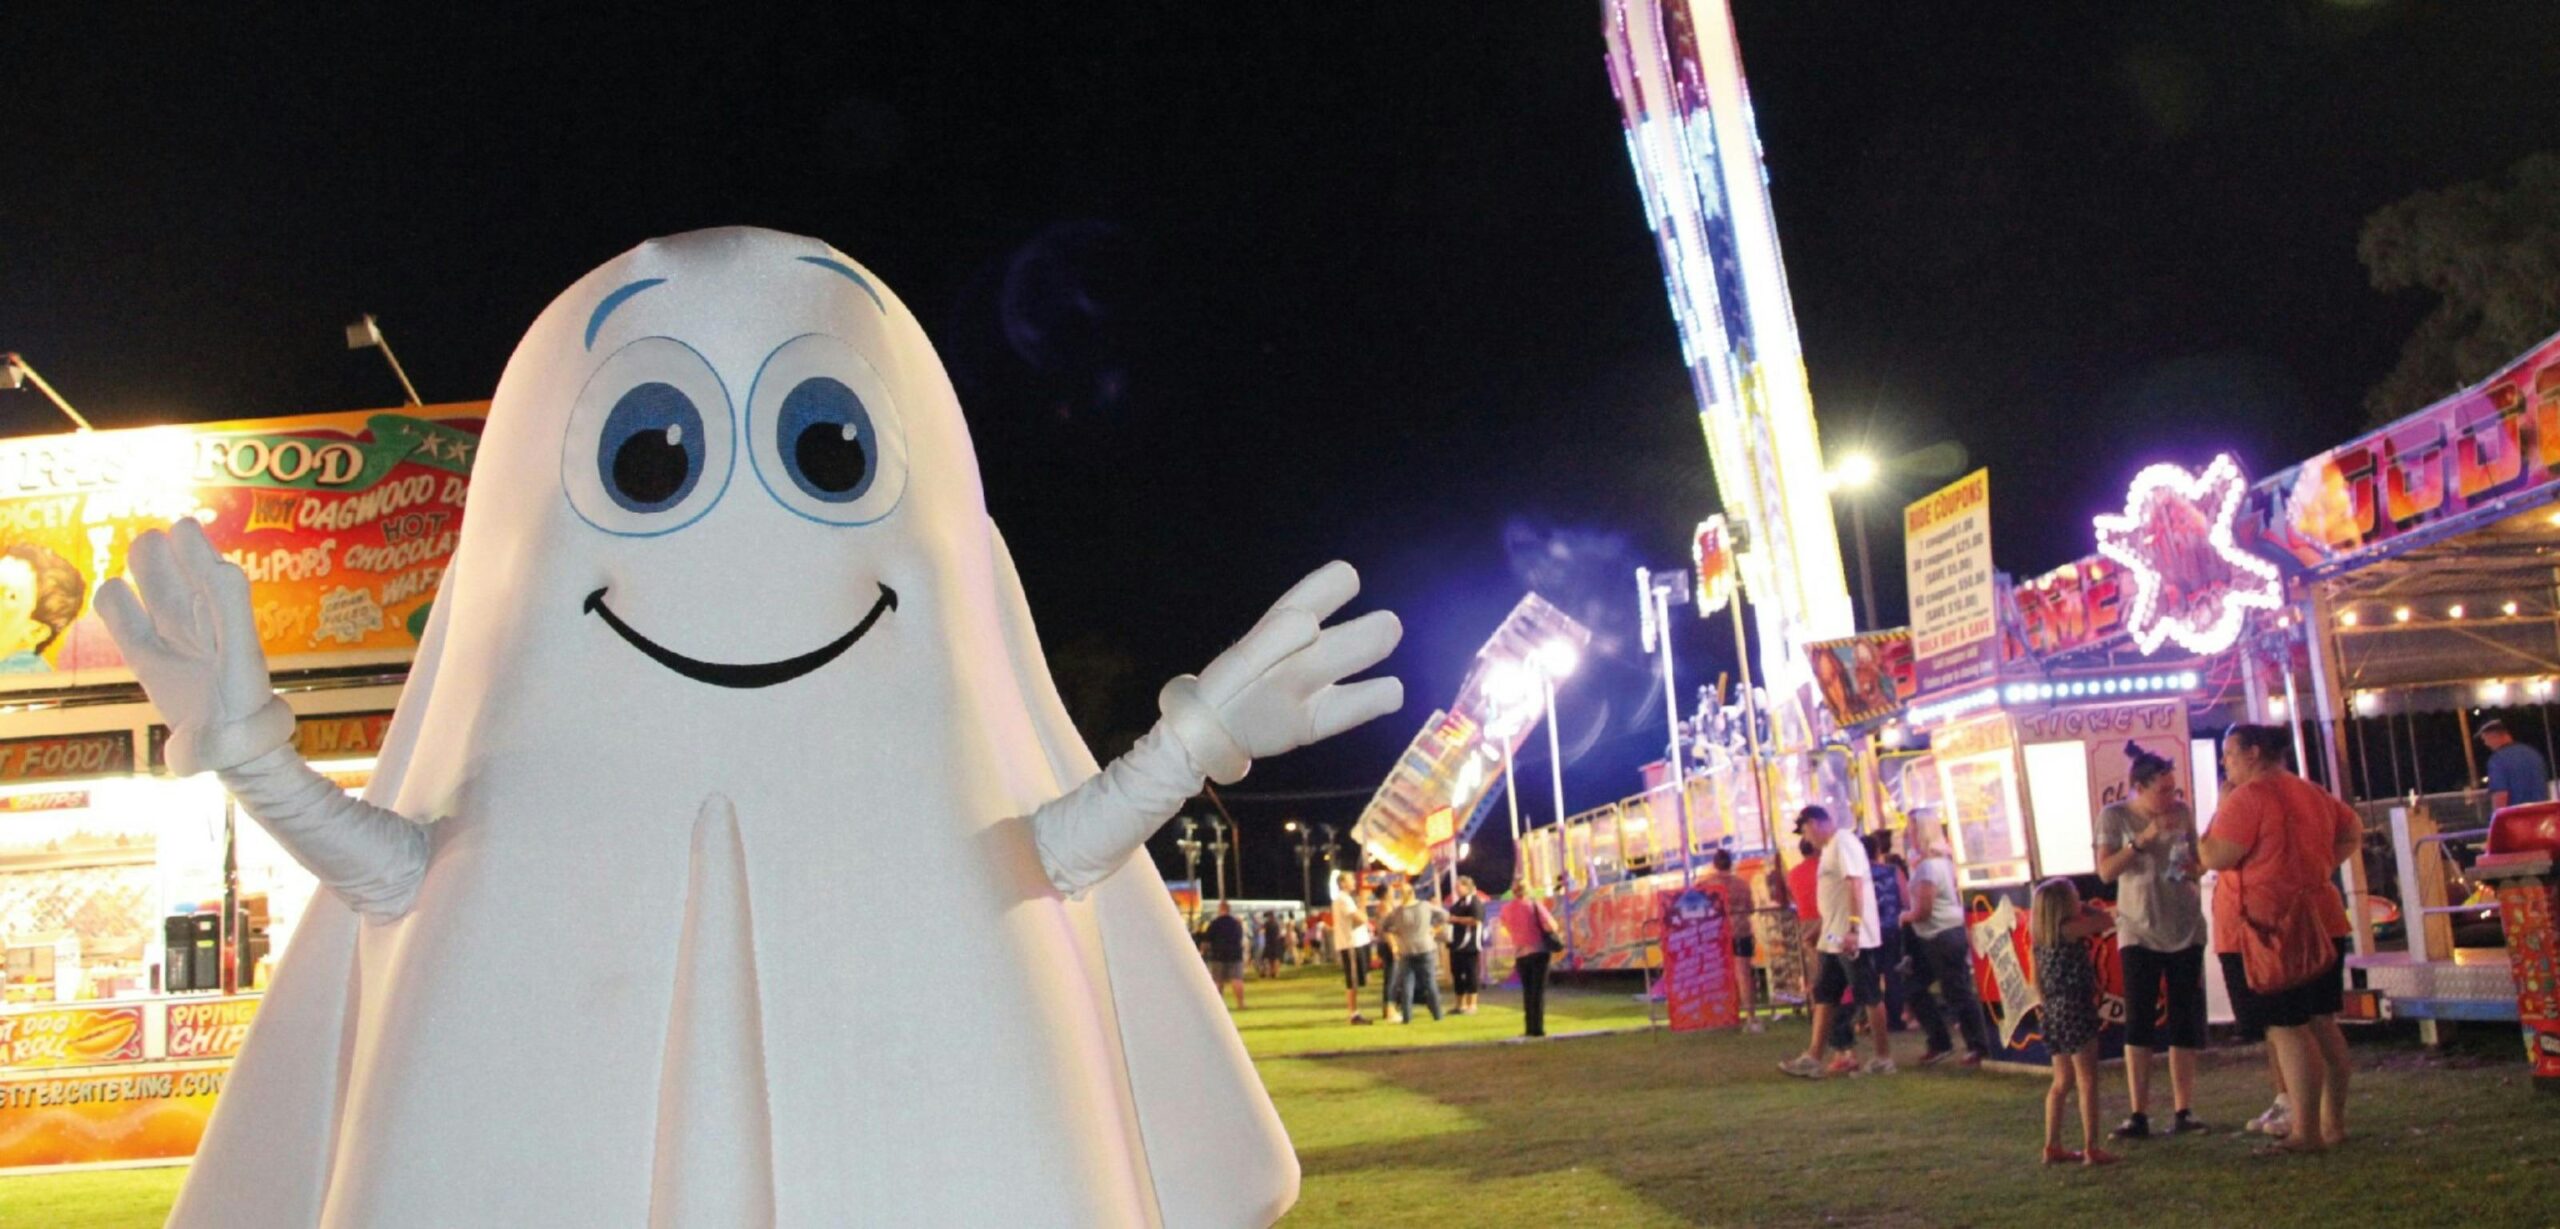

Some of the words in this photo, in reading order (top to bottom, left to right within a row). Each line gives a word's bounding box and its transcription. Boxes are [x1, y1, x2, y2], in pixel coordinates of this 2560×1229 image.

[194, 437, 363, 486] FOOD
[255, 500, 295, 525] HOT
[298, 474, 434, 530] DAGWOOD
[1935, 479, 1983, 520] COUPONS
[381, 511, 449, 545] HOT
[2023, 704, 2176, 737] TICKETS
[23, 1015, 69, 1036] DOG
[172, 1004, 254, 1027] PIPING
[14, 1034, 68, 1061] ROLL
[171, 1025, 249, 1055] CHIP
